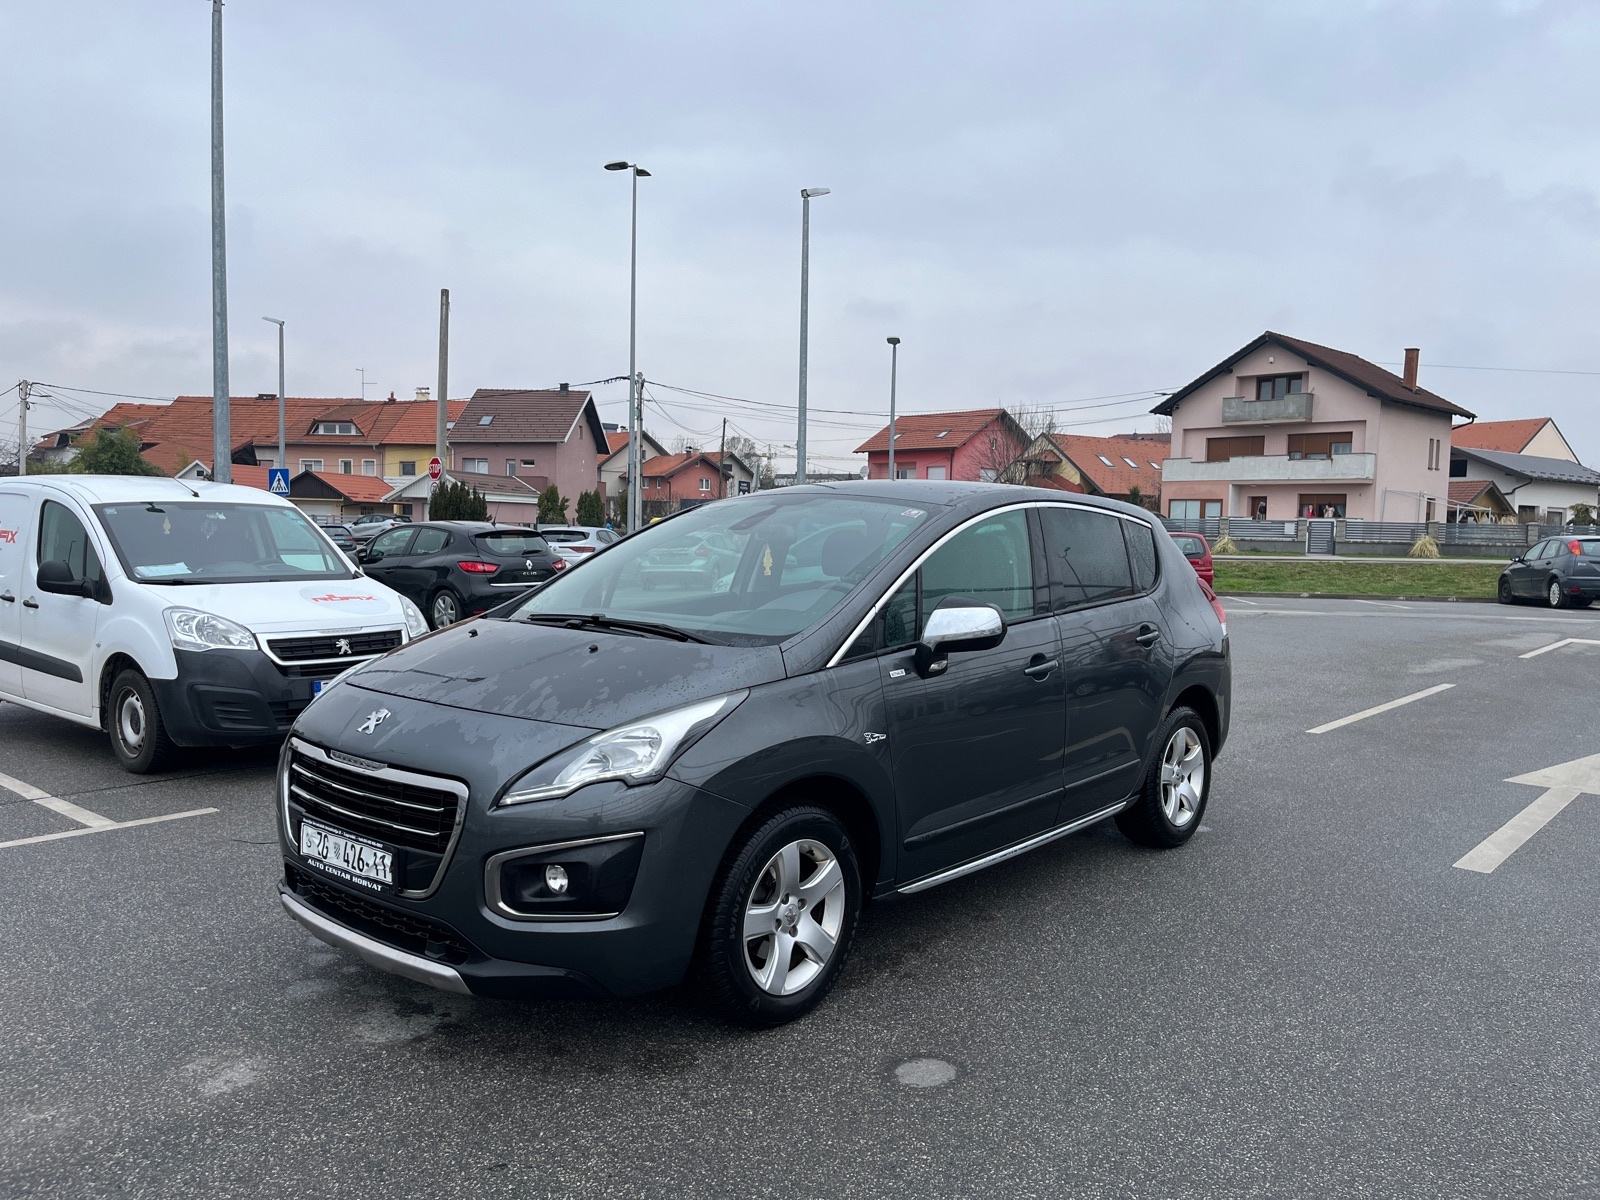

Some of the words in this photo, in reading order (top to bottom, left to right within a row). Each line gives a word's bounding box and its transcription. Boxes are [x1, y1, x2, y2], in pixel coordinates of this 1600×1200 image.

[429, 463, 441, 473] STOP
[307, 858, 324, 870] AUTO
[325, 866, 351, 880] CENTAR
[352, 876, 382, 892] HORVAT
